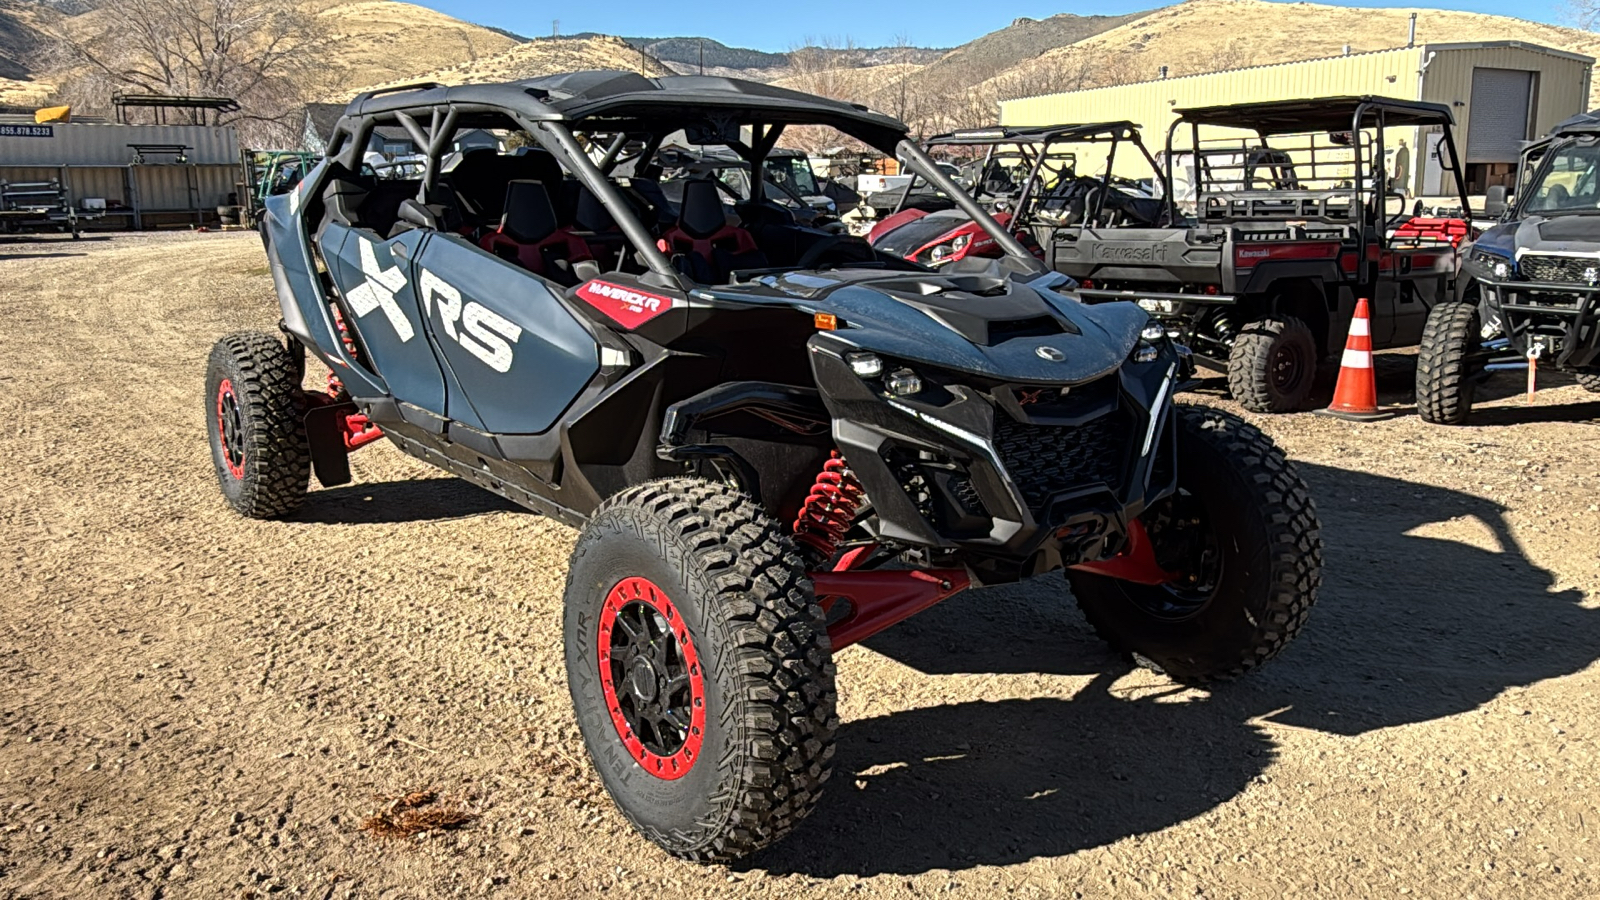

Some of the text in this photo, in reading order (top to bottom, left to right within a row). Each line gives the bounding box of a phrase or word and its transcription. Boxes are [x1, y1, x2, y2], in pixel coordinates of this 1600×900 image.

[1091, 243, 1168, 262] Kawasaki
[1239, 248, 1270, 258] Kawasaki
[588, 282, 661, 312] MAVERICK R
